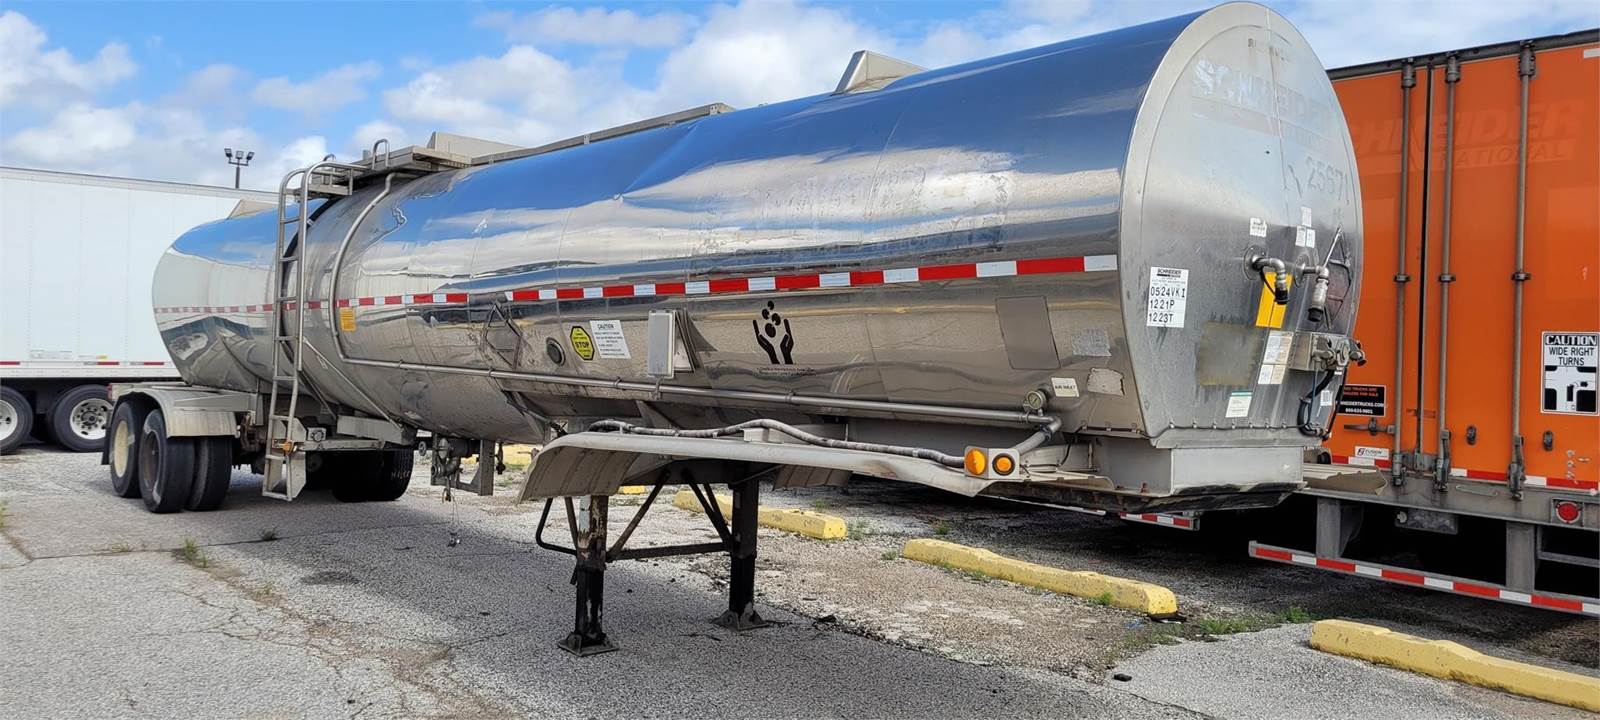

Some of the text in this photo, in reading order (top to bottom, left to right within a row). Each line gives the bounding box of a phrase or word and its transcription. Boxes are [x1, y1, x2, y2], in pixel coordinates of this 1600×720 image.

[1150, 299, 1175, 309] 1221P
[1149, 312, 1174, 323] 1223T
[1546, 335, 1597, 346] CAUTION
[1549, 346, 1595, 357] WIDE RIGHT
[1558, 356, 1585, 366] TURNS
